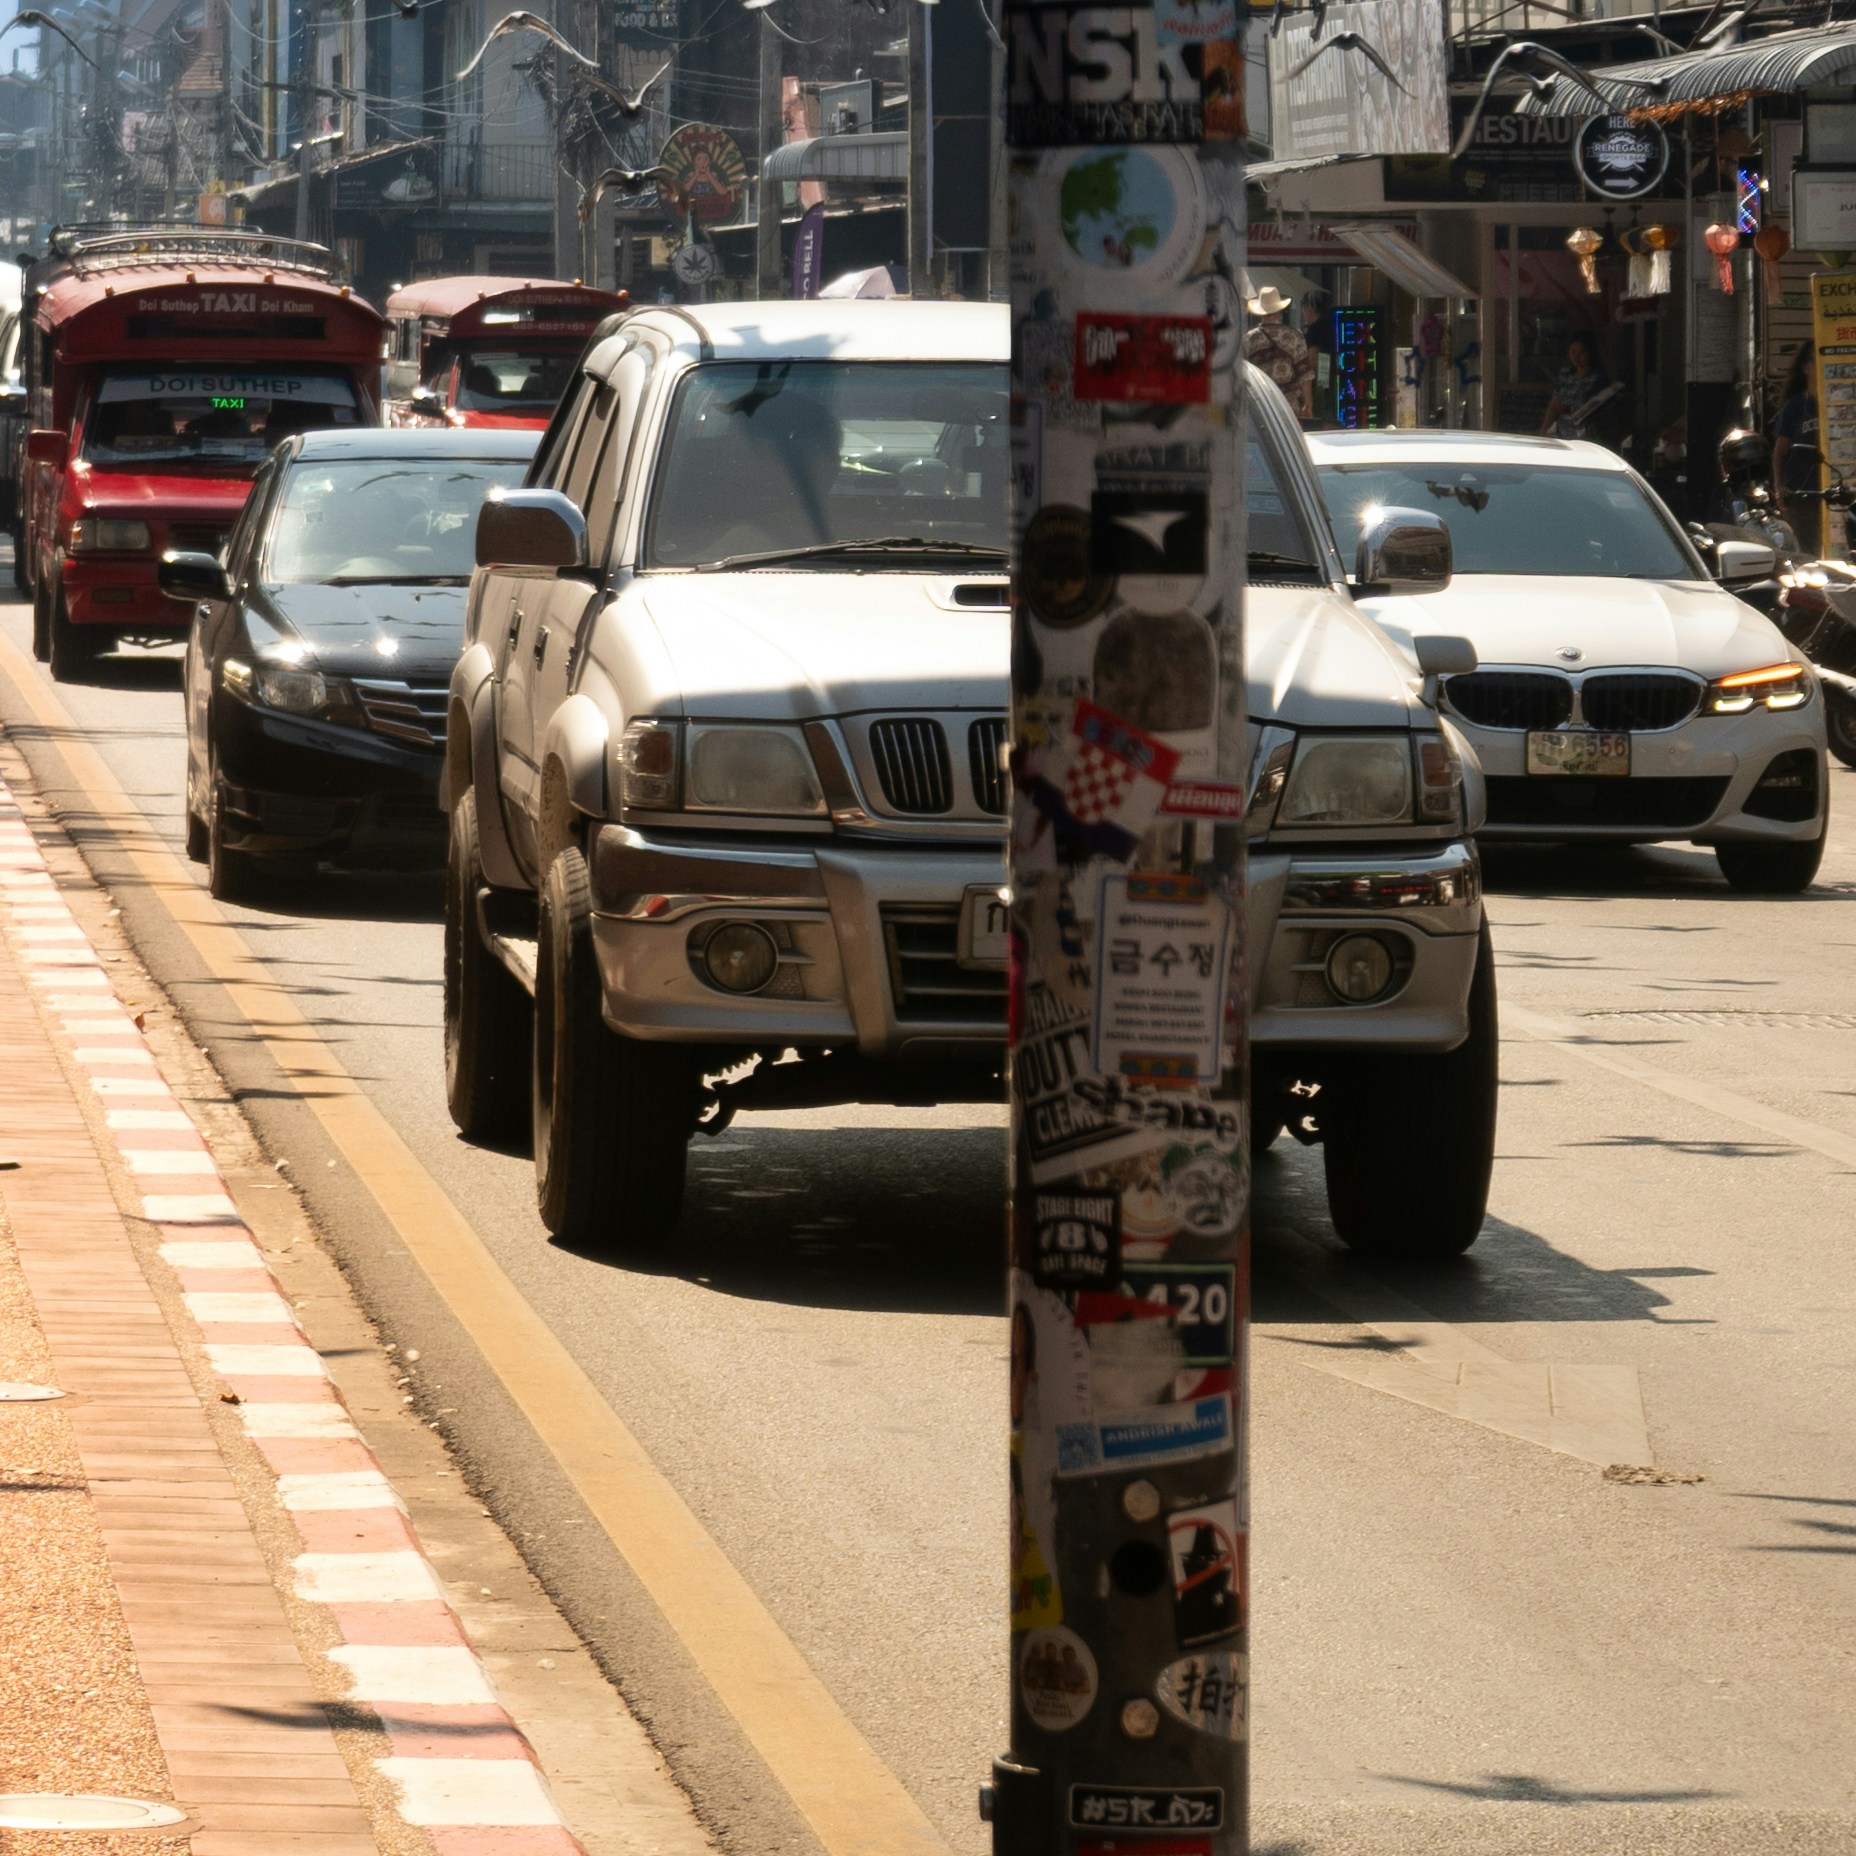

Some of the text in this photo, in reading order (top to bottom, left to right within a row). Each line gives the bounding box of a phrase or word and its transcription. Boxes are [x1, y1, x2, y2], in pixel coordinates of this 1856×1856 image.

[1594, 144, 1651, 153] RENEGADE
[139, 292, 314, 313] Doi Suthep TAXI Doi Kham
[149, 377, 303, 395] DOI SUTHEP
[212, 398, 245, 409] TAXI
[1571, 734, 1626, 757] 6556
[1036, 1194, 1115, 1228] STAGE EIGHT
